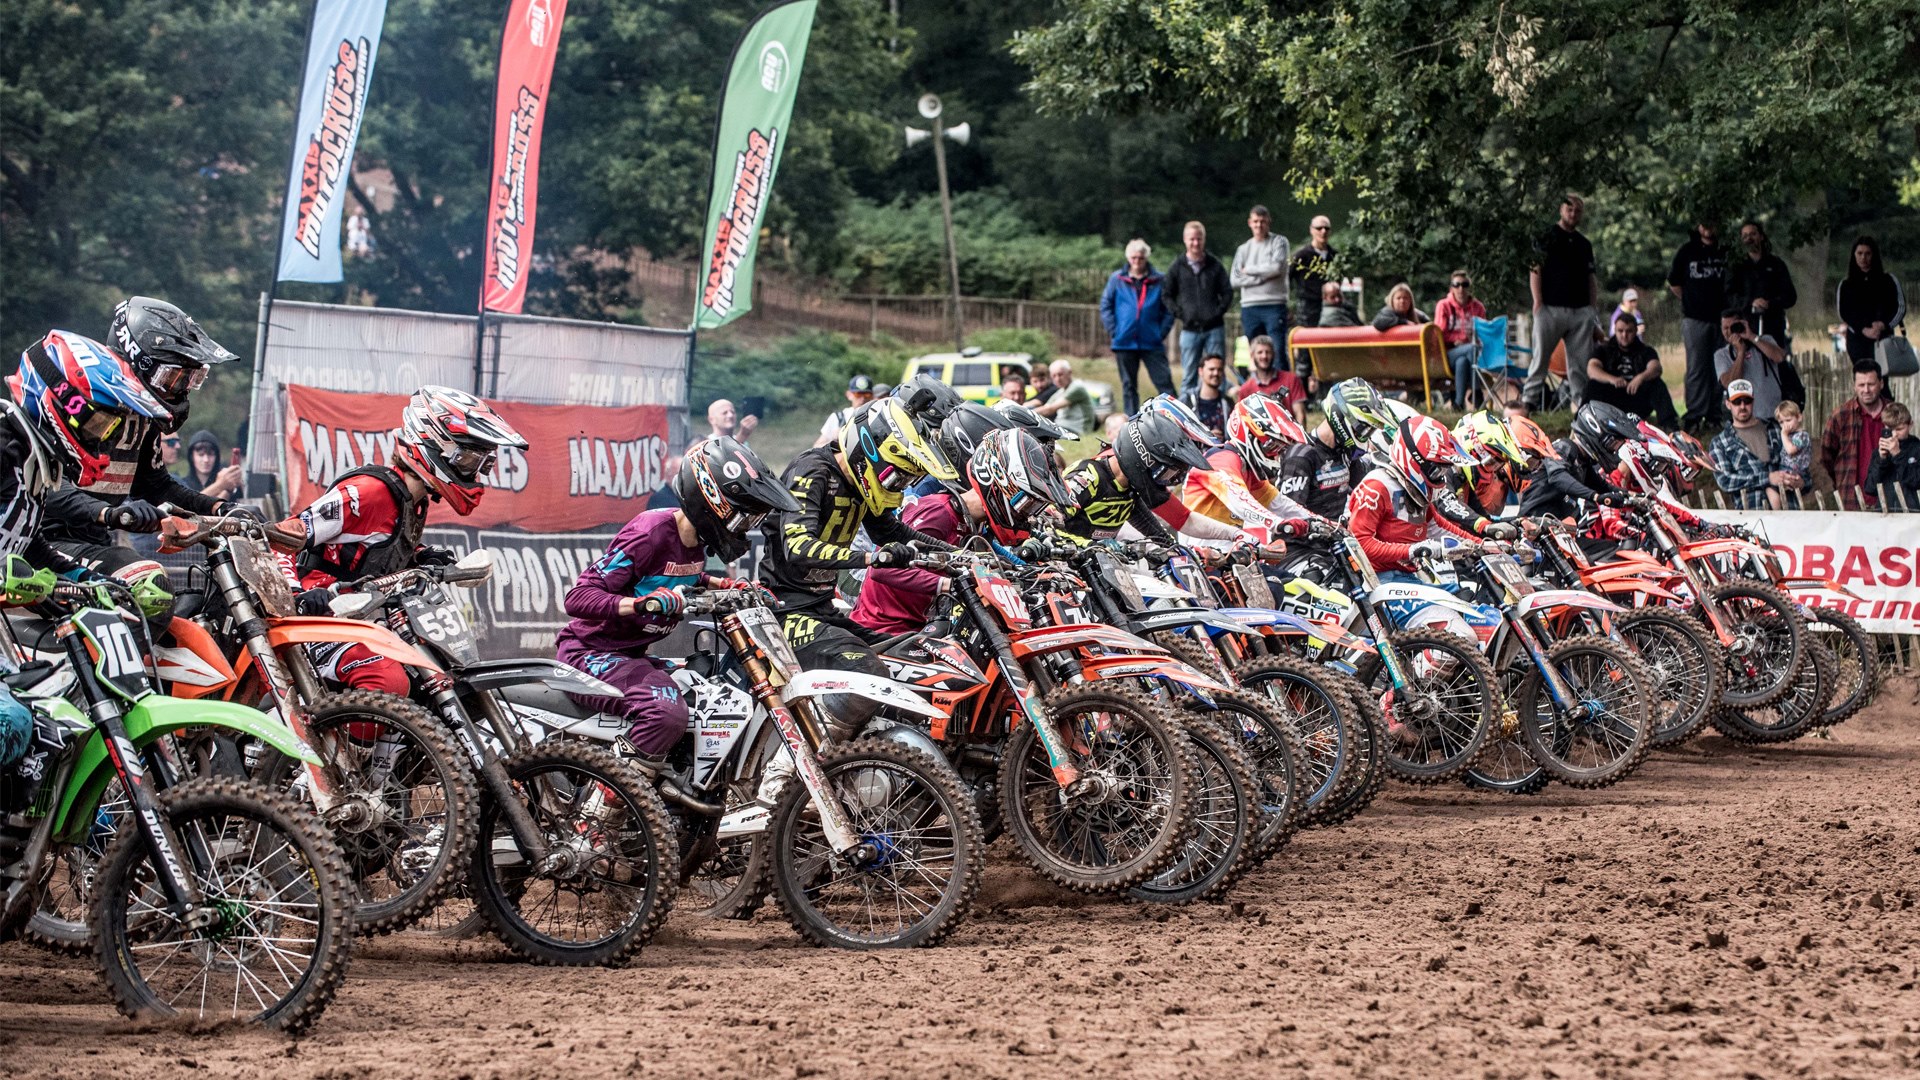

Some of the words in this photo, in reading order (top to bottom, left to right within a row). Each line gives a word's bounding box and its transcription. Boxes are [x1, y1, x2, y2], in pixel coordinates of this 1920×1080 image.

[761, 52, 779, 92] ACU
[301, 38, 357, 260] MOTOCROSS
[295, 142, 321, 243] MAXXIS
[711, 128, 771, 319] MOTOCROSS
[703, 214, 731, 308] MAXXIS
[299, 417, 401, 488] MAXX
[568, 433, 661, 499] MAXXIS
[1411, 451, 1424, 465] FOX
[486, 546, 549, 614] PRO
[1388, 588, 1419, 597] revo
[95, 621, 148, 679] 10
[416, 604, 469, 642] 537
[783, 613, 821, 640] FLY
[922, 641, 941, 658] PAR
[940, 652, 978, 678] HOMES
[741, 811, 770, 824] RFX
